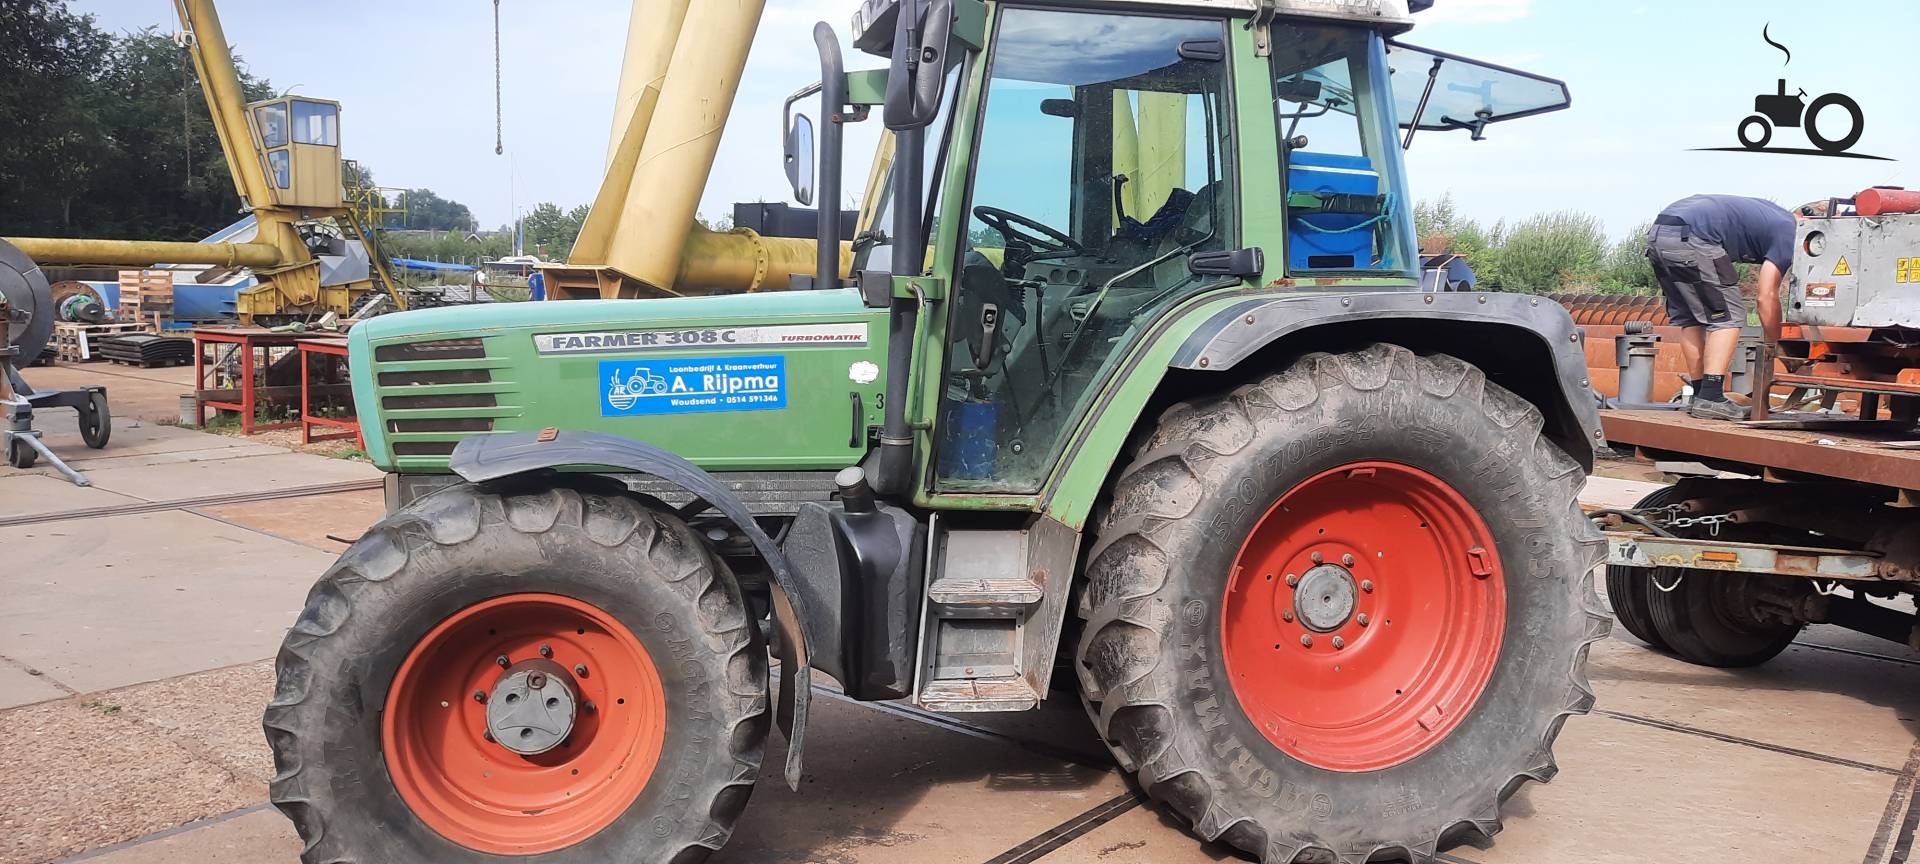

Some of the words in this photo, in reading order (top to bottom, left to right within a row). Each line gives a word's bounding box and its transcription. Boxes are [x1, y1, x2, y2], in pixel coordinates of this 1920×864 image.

[552, 332, 659, 349] FARMER
[664, 330, 718, 345] 308
[721, 330, 736, 343] C
[780, 333, 863, 342] TURBOMATIK
[669, 365, 715, 373] Loonbedrijf
[724, 363, 777, 371] Kraanverhuur
[671, 375, 694, 393] A.
[703, 373, 778, 395] Rijpma
[671, 396, 717, 406] Woudsend
[726, 395, 746, 404] 0514
[748, 394, 778, 403] 591346
